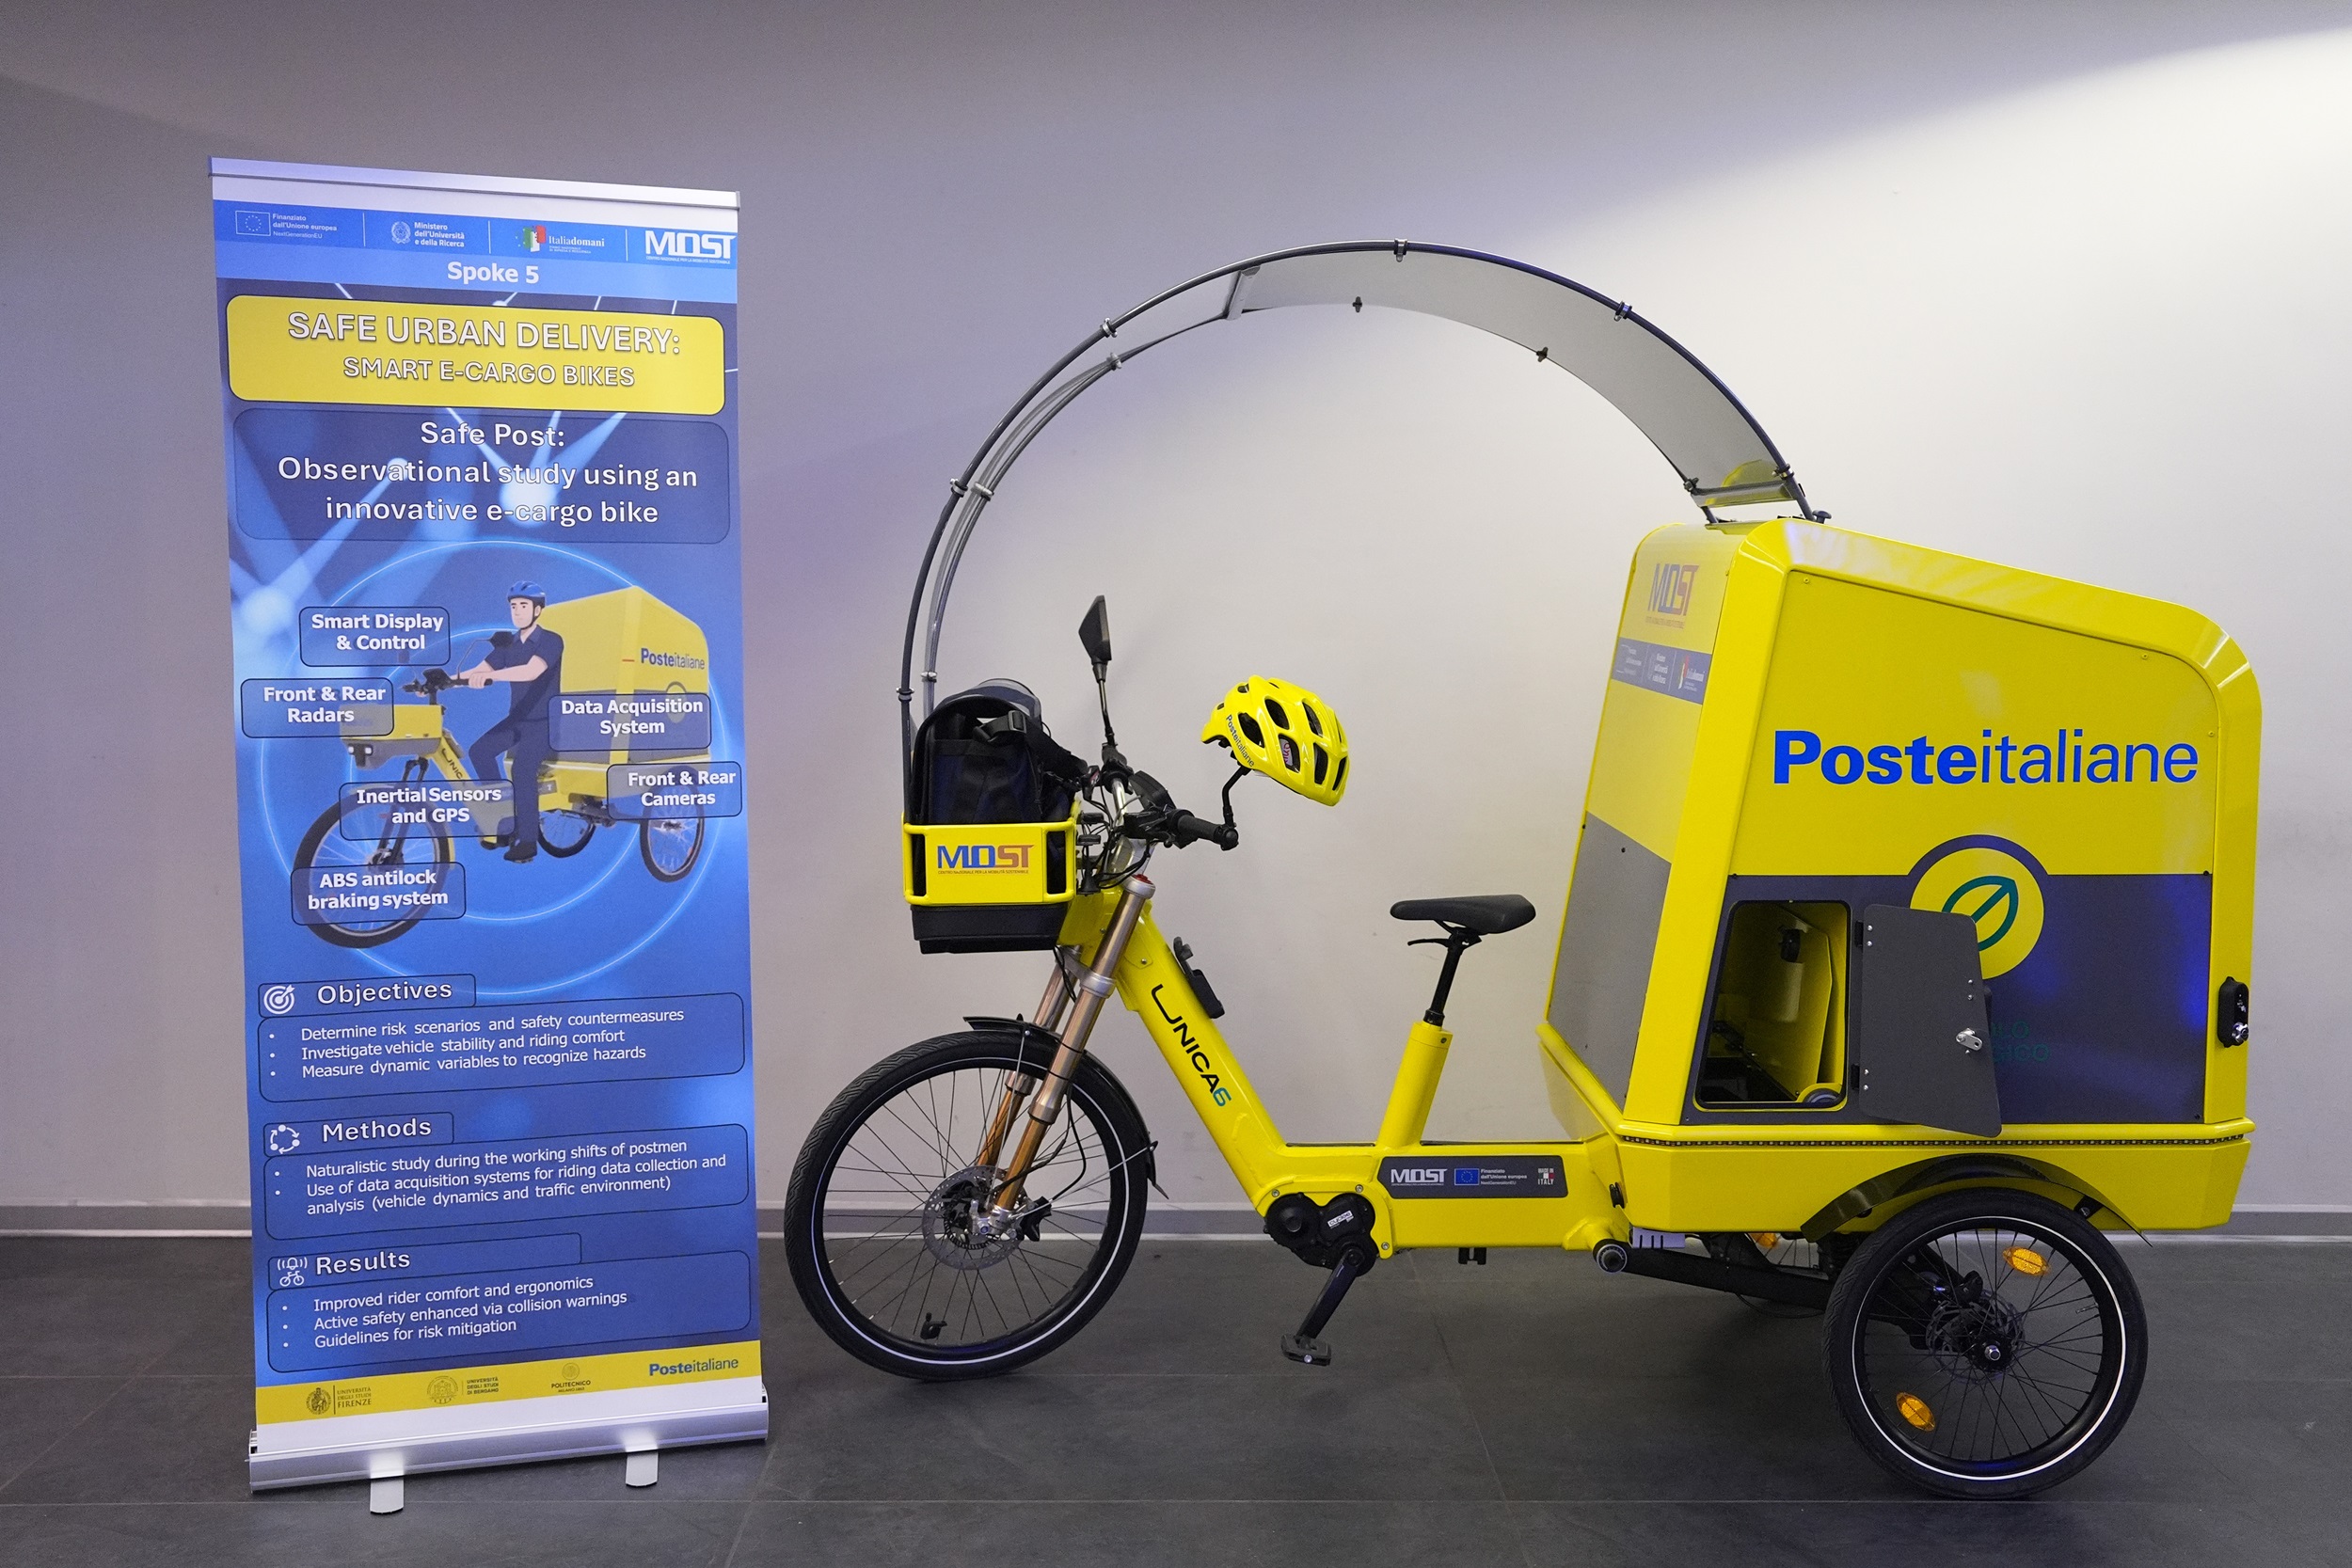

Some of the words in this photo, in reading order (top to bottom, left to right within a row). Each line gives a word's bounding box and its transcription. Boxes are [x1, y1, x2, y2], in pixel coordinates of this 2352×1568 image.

[414, 222, 448, 230] Ministero
[414, 230, 465, 239] dell'Università
[549, 236, 604, 247] Italiadomani
[645, 230, 736, 259] MOST
[447, 261, 519, 285] Spoke
[525, 265, 539, 284] 5
[287, 312, 377, 343] SAFE
[386, 316, 506, 348] URBAN
[516, 322, 681, 355] DELIVERY:
[343, 357, 432, 381] SMART
[440, 360, 556, 385] E-CARGO
[564, 365, 635, 387] BIKES
[420, 421, 486, 446] Safe
[494, 423, 565, 448] Post:
[278, 456, 489, 484] Observational
[498, 462, 577, 490] study
[584, 464, 660, 492] using
[666, 468, 697, 488] an
[326, 497, 478, 522] innovative
[486, 502, 592, 528] e-cargo
[600, 500, 659, 523] bike
[1648, 563, 1699, 616] MOST
[311, 614, 370, 629] Smart
[375, 614, 444, 632] Display
[336, 635, 351, 650] &
[357, 634, 425, 650] Control
[641, 648, 705, 670] Posteitaliane
[264, 687, 316, 702] Front
[321, 687, 337, 702] &
[342, 686, 386, 701] Rear
[287, 707, 354, 723] Radars
[562, 700, 603, 714] Data
[607, 699, 703, 716] Acquisition
[600, 720, 665, 737] System
[1225, 714, 1255, 767] Posteitaliane
[1773, 728, 2199, 785] Posteitaliane
[628, 772, 675, 786] Front
[680, 771, 693, 785] &
[698, 771, 736, 784] Rear
[357, 787, 426, 804] Inertial
[429, 788, 502, 802] Sensors
[641, 792, 716, 807] Cameras
[391, 808, 426, 824] and
[432, 808, 470, 823] GPS
[937, 845, 1034, 869] MOST
[319, 873, 358, 888] ABS
[361, 870, 437, 887] antilock
[308, 895, 380, 910] braking
[382, 893, 448, 909] system
[317, 981, 453, 1006] Objectives
[301, 1025, 377, 1041] Determine
[381, 1022, 406, 1036] risk
[414, 1020, 481, 1034] scenarios
[488, 1017, 515, 1031] and
[521, 1014, 562, 1029] safety
[568, 1009, 684, 1026] countermeasures
[302, 1043, 382, 1060] Investigate
[385, 1040, 434, 1055] vehicle
[441, 1037, 495, 1053] stability
[499, 1035, 525, 1049] and
[529, 1033, 568, 1048] riding
[572, 1029, 625, 1045] comfort
[1151, 983, 1232, 1107] UNICA6
[302, 1063, 364, 1078] Measure
[370, 1059, 430, 1076] dynamic
[437, 1054, 500, 1070] variables
[503, 1053, 517, 1066] to
[523, 1049, 588, 1066] recognize
[593, 1045, 646, 1061] hazards
[322, 1117, 432, 1143] Methods
[306, 1160, 387, 1178] Naturalistic
[391, 1156, 430, 1172] study
[435, 1154, 480, 1169] during
[484, 1152, 508, 1165] the
[511, 1148, 566, 1163] working
[570, 1144, 607, 1159] shifts
[611, 1143, 626, 1156] of
[629, 1141, 687, 1157] postmen
[307, 1184, 334, 1196] Use
[339, 1180, 353, 1194] of
[358, 1178, 389, 1192] data
[394, 1173, 469, 1190] acquisition
[474, 1170, 530, 1186] systems
[534, 1167, 554, 1180] for
[558, 1164, 596, 1179] riding
[601, 1162, 630, 1175] data
[635, 1156, 698, 1172] collection
[701, 1154, 726, 1168] and
[1391, 1169, 1448, 1183] MOST
[307, 1198, 364, 1215] analysis
[372, 1193, 426, 1212] (vehicle
[433, 1189, 499, 1207] dynamics
[503, 1186, 529, 1200] and
[535, 1182, 575, 1197] traffic
[580, 1175, 671, 1193] environment)
[316, 1251, 411, 1275] Results
[314, 1292, 383, 1313] Improved
[388, 1291, 421, 1305] rider
[425, 1285, 480, 1301] comfort
[484, 1283, 510, 1296] and
[515, 1276, 594, 1295] ergonomics
[314, 1315, 358, 1330] Active
[363, 1310, 405, 1326] safety
[410, 1304, 478, 1322] enhanced
[483, 1303, 503, 1315] via
[507, 1298, 562, 1313] collision
[565, 1292, 628, 1308] warnings
[314, 1329, 389, 1348] Guidelines
[393, 1326, 413, 1340] for
[418, 1324, 443, 1338] risk
[447, 1320, 516, 1337] mitigation
[649, 1356, 739, 1376] Posteitaliane
[551, 1380, 591, 1389] POLITECNICO
[337, 1399, 371, 1408] FIRENZE
